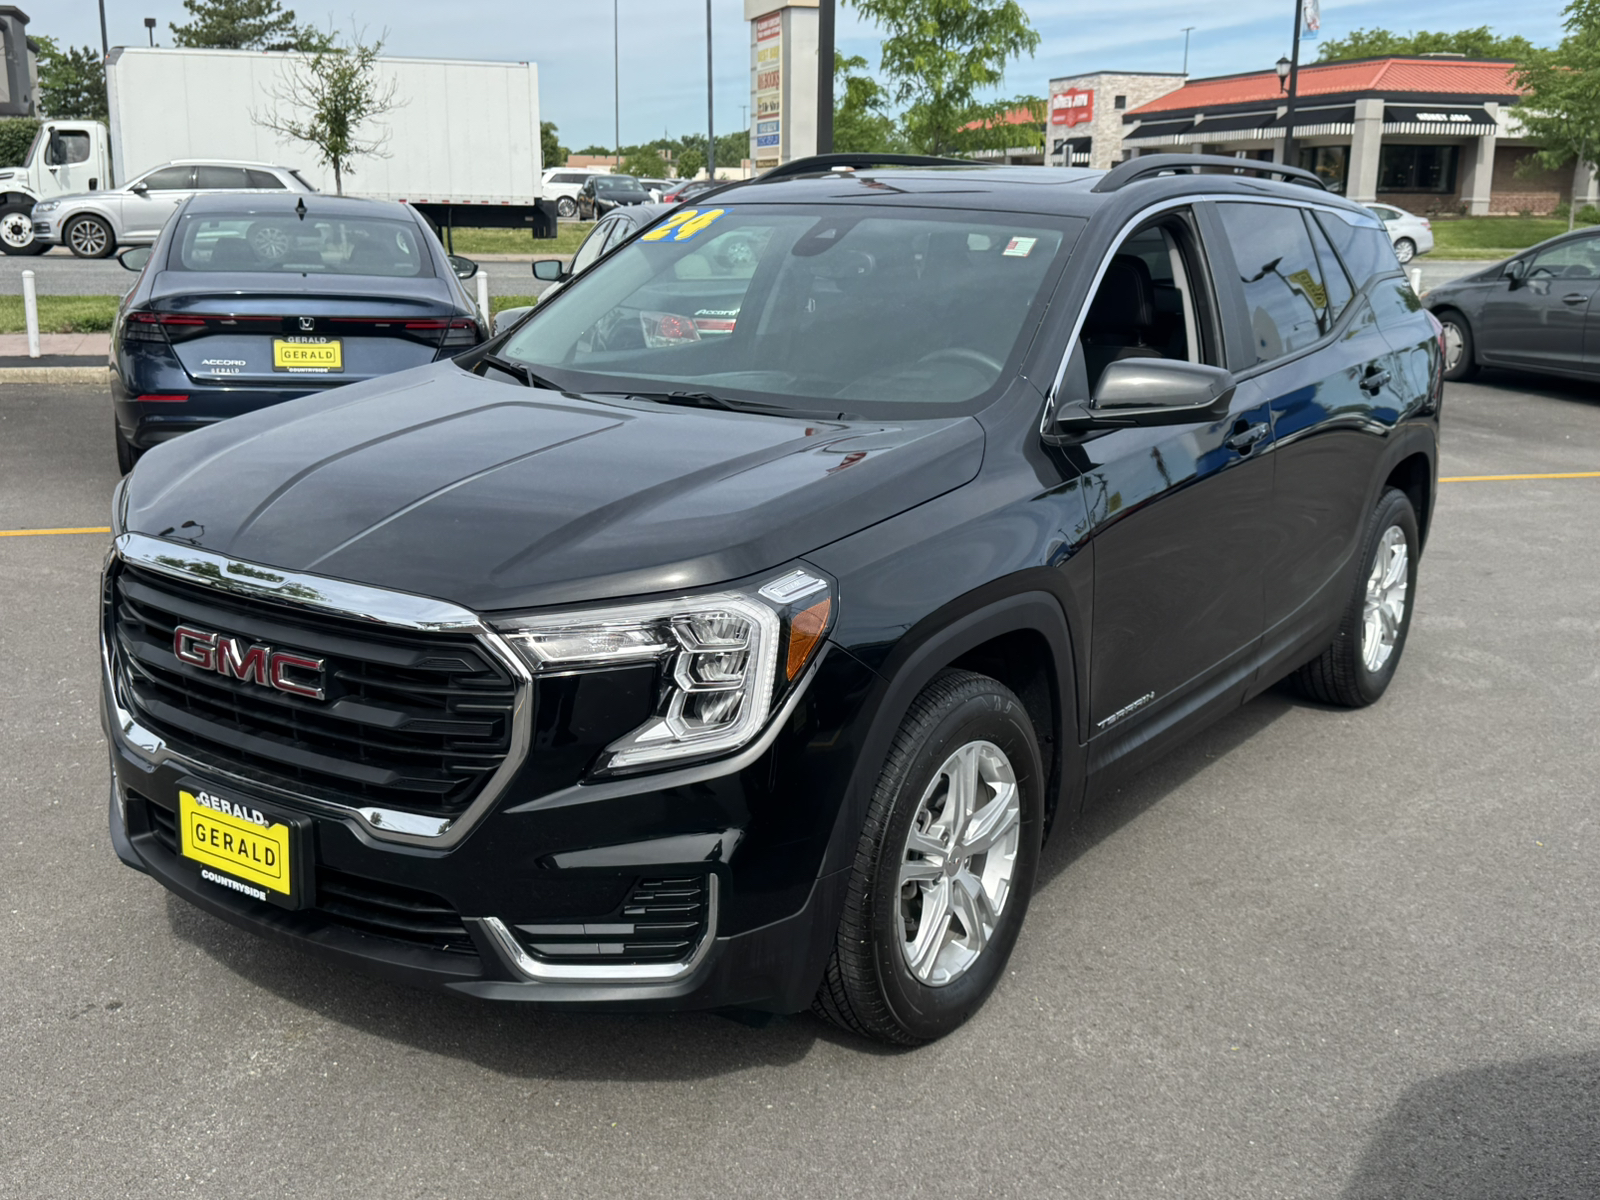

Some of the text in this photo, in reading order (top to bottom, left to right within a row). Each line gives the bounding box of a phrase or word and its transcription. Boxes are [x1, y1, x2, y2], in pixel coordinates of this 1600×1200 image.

[641, 208, 725, 242] 24
[694, 308, 738, 316] Accord
[284, 350, 333, 360] GERALD
[287, 336, 327, 344] GERALD
[173, 625, 326, 701] GMC
[198, 791, 266, 826] GERALD
[195, 822, 276, 867] GERALD
[201, 869, 267, 901] COUNTRYSIDE
